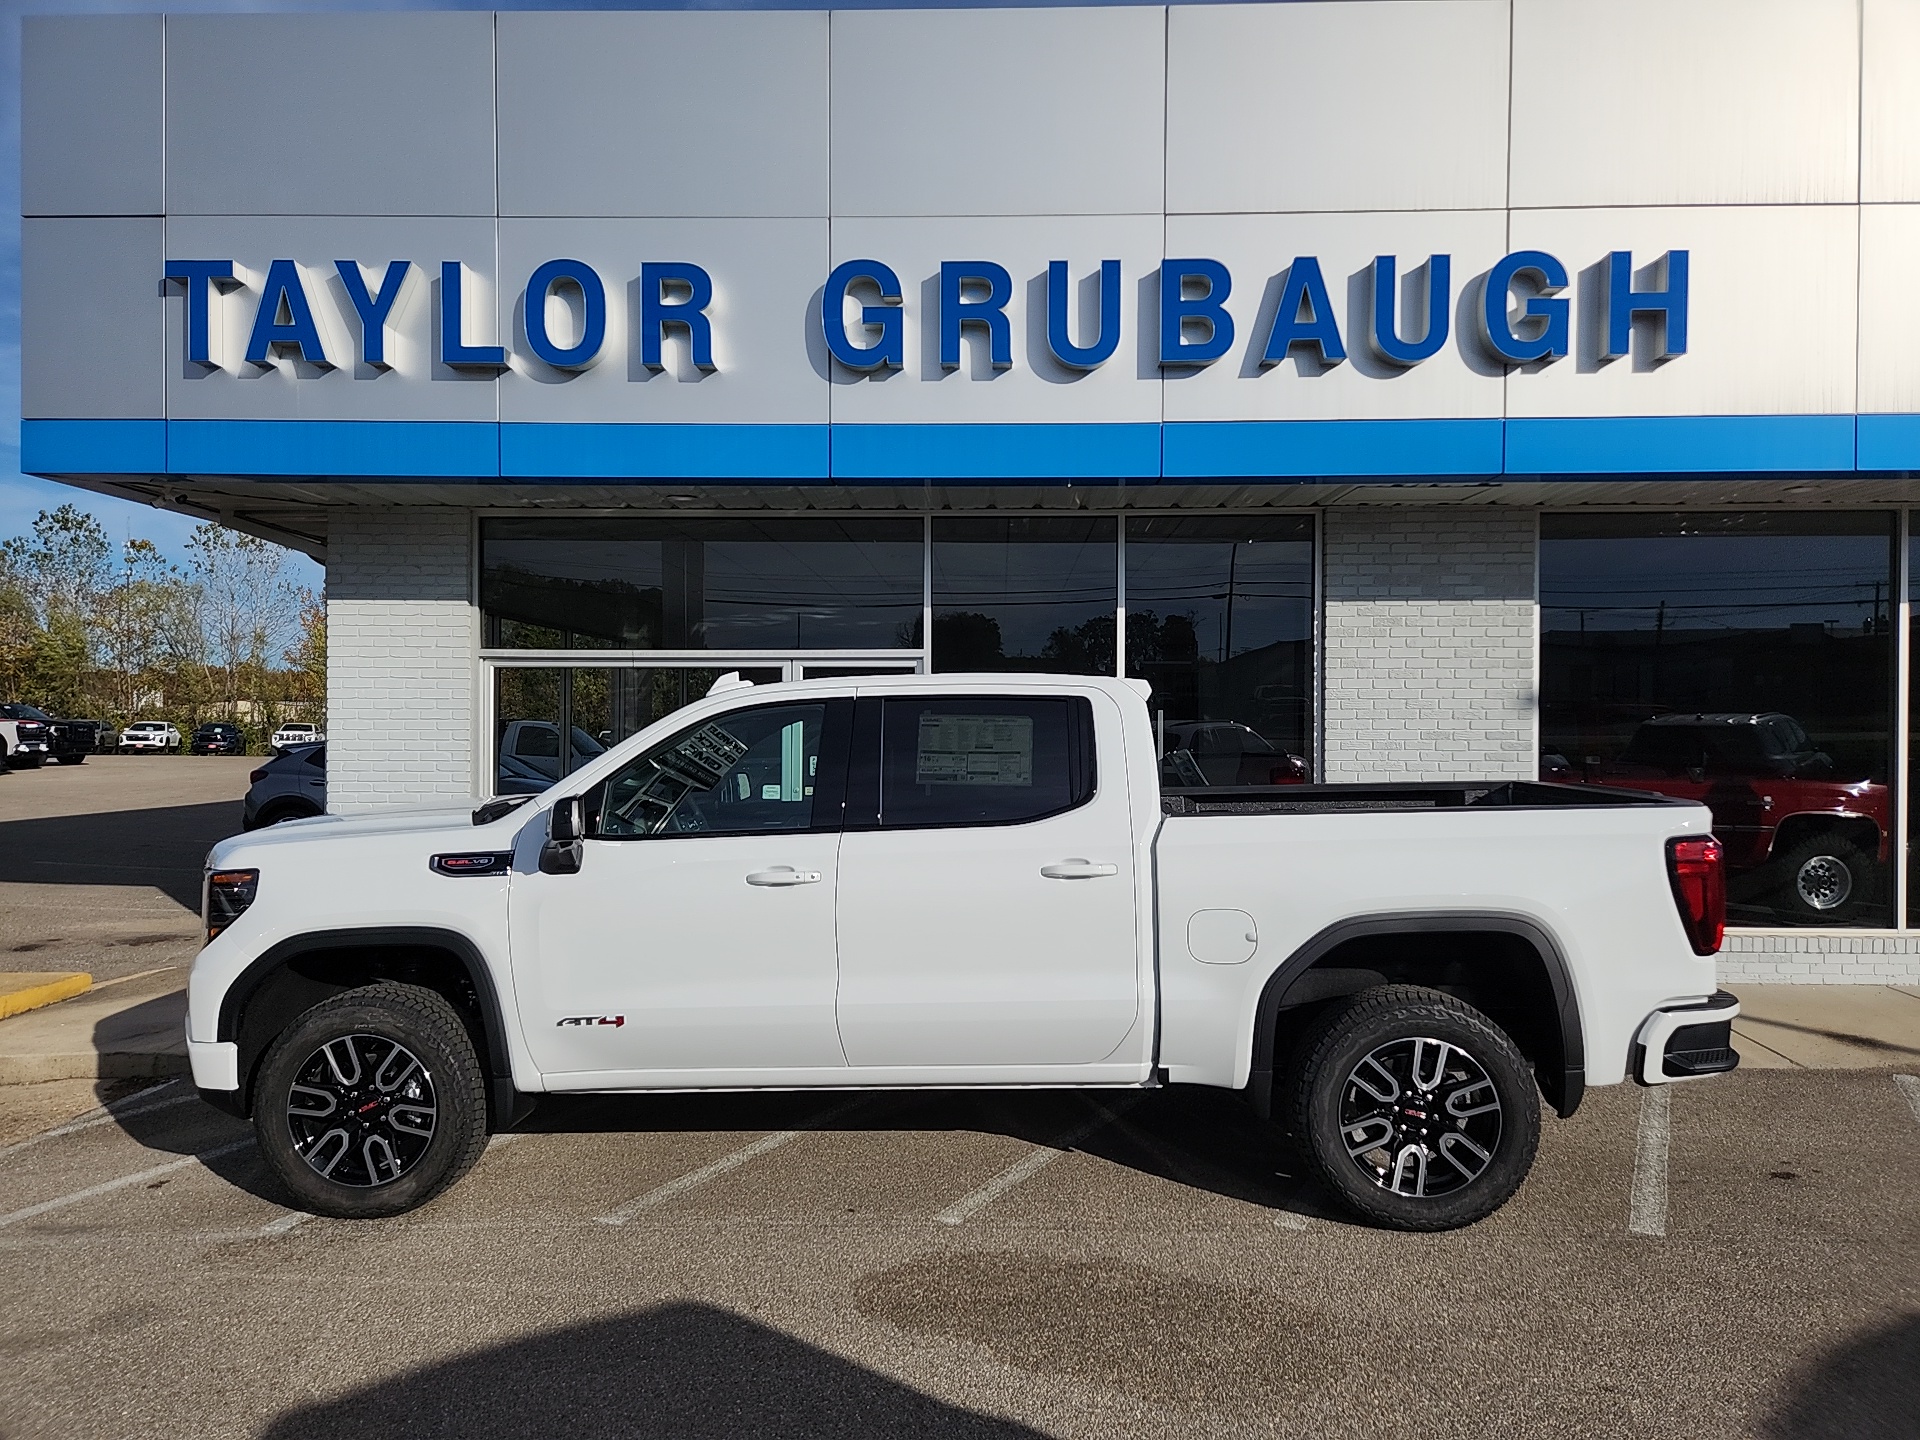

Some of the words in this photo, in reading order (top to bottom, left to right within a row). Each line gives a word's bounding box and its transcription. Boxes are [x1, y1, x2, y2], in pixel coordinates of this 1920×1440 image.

[164, 257, 718, 371] TAYLOR
[821, 248, 1690, 369] GRUBAUGH
[556, 1015, 625, 1029] AT4
